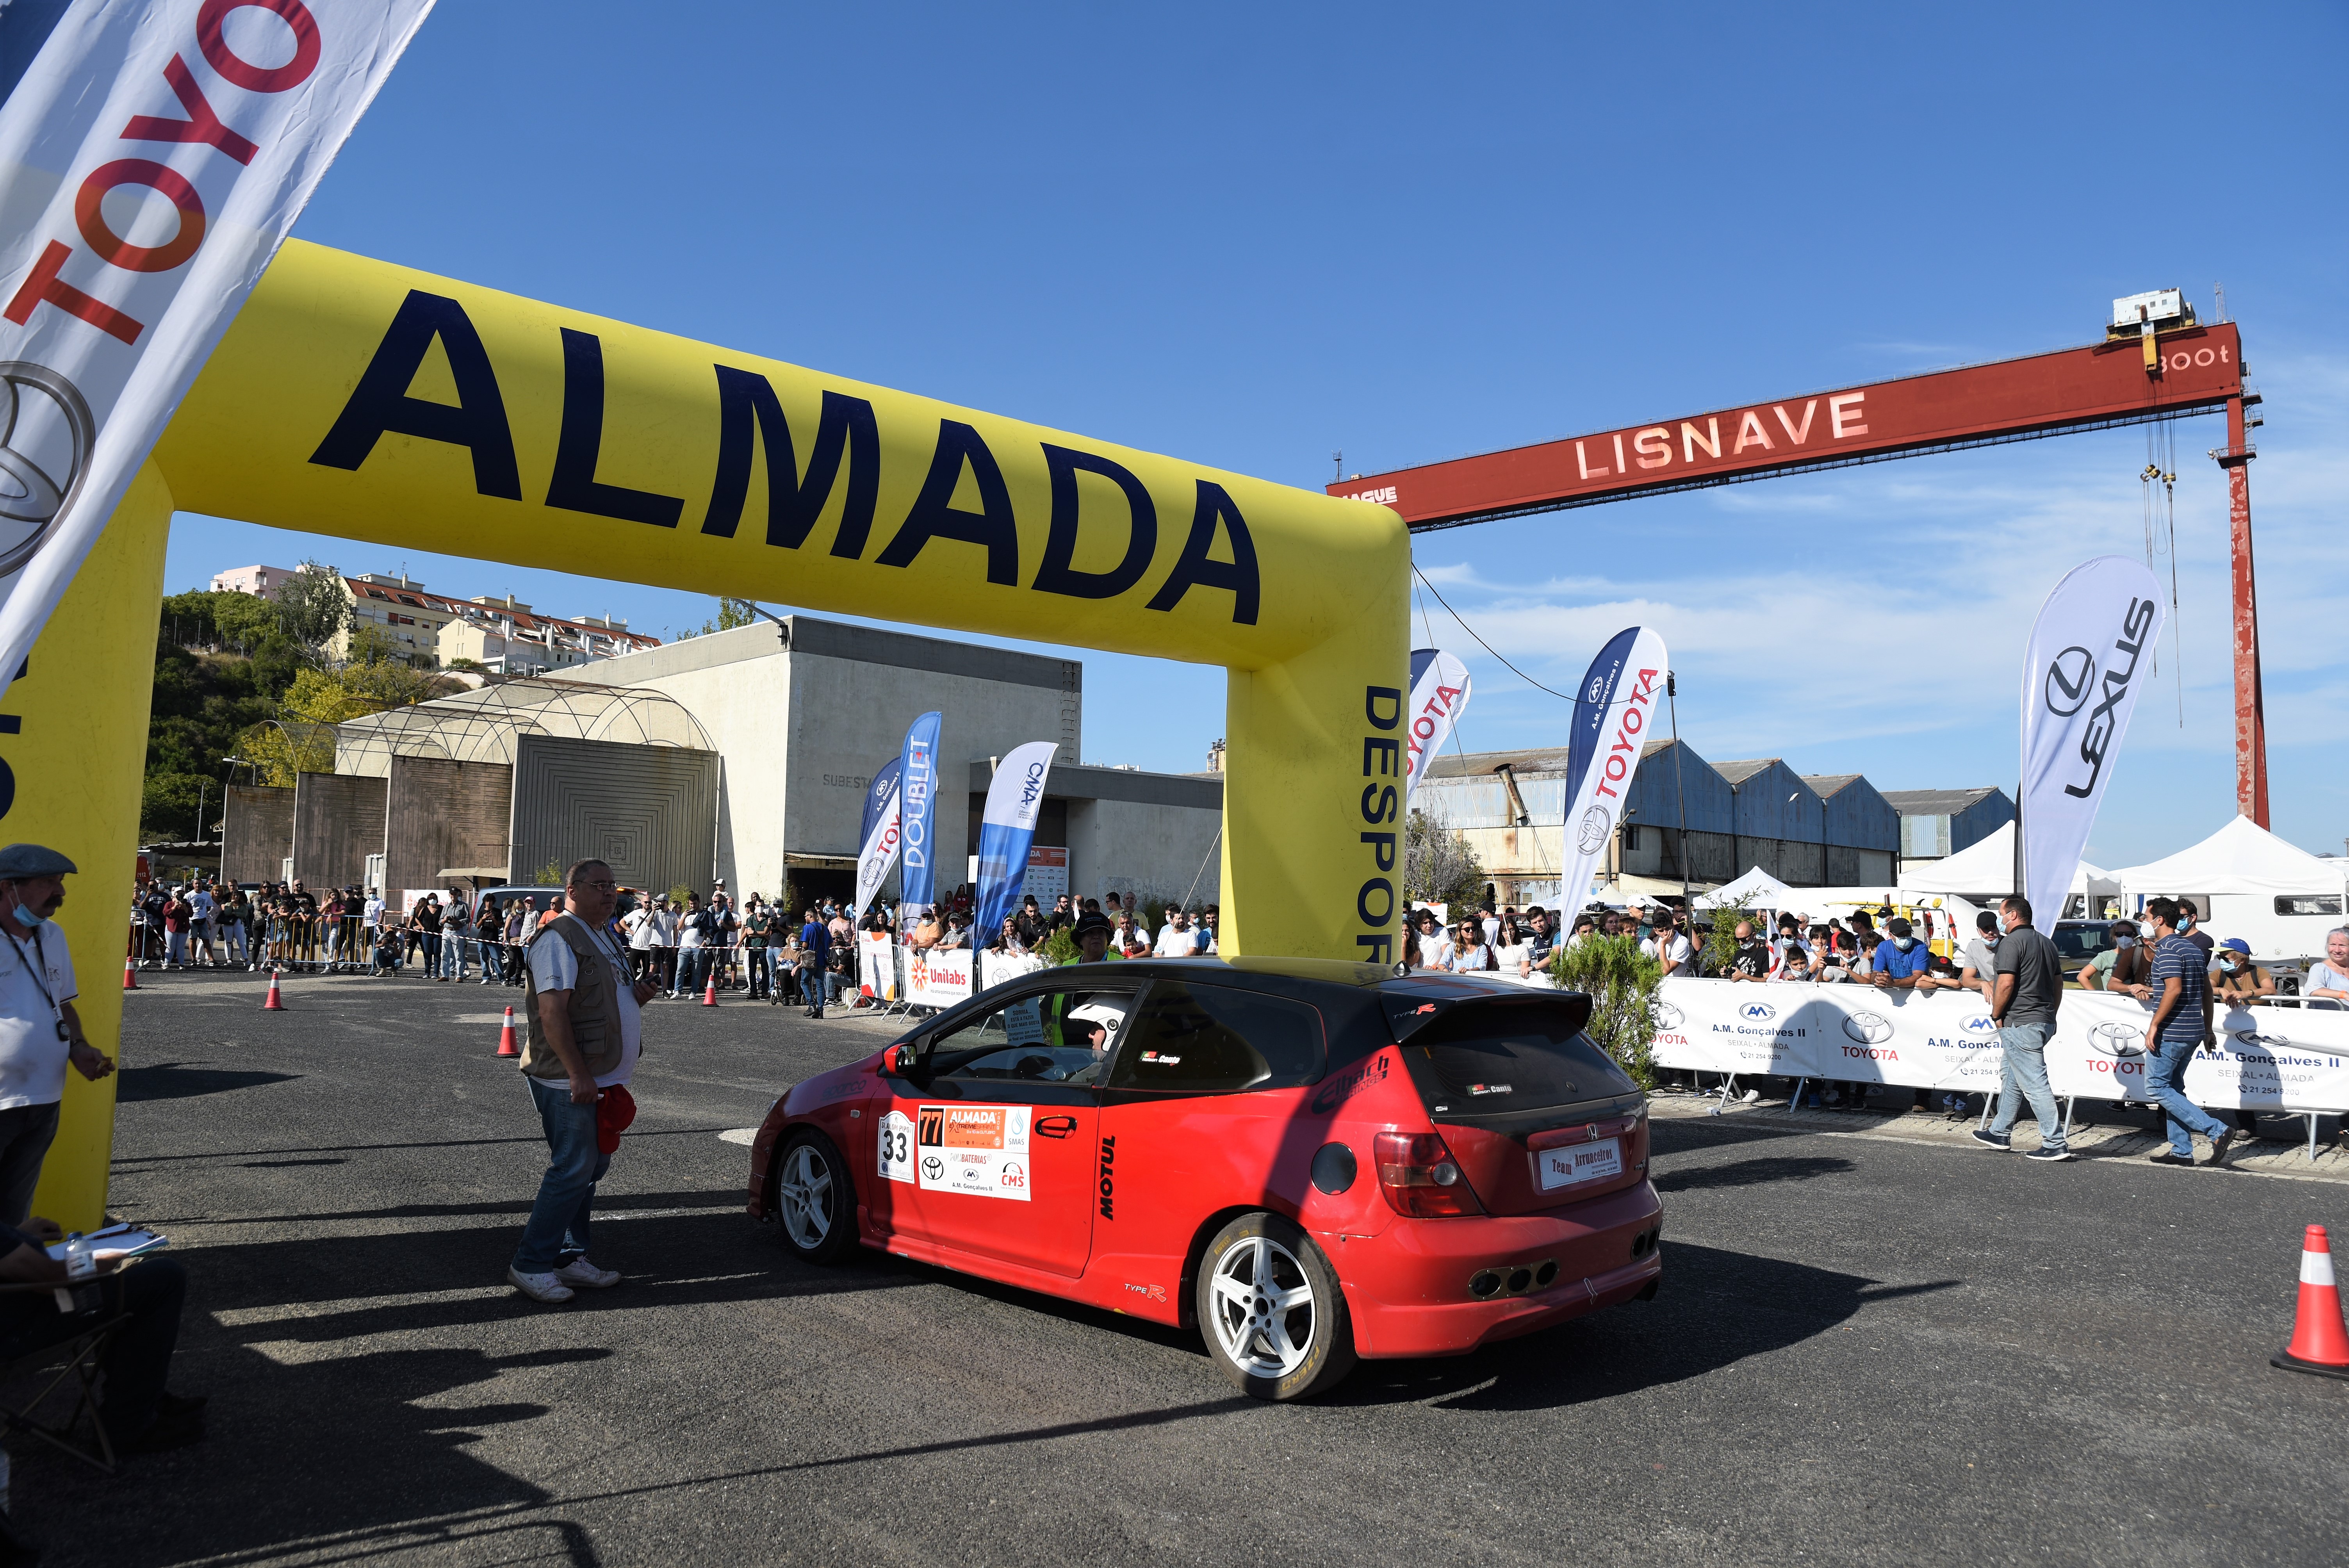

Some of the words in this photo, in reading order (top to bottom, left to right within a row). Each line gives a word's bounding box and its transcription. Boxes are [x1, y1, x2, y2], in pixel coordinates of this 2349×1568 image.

[1576, 392, 1870, 479] LISNAVE
[308, 289, 1259, 626] ALMADA
[1343, 486, 1397, 503] AGUE
[1592, 712, 1601, 729] A.M.
[1598, 670, 1616, 711] Gonçalves
[2064, 597, 2155, 798] LEXUS
[1407, 686, 1461, 776] YOTA
[1595, 669, 1658, 798] TOYOTA
[1021, 763, 1043, 805] CMA
[905, 735, 930, 868] DOUBLET
[930, 968, 966, 985] Unilabs
[1393, 1009, 1416, 1019] TYPE
[1416, 1004, 1436, 1015] R
[1713, 1024, 1734, 1033] A.M.
[1738, 1026, 1794, 1037] Gonçalves
[1798, 1028, 1805, 1037] II
[1727, 1039, 1753, 1048] SEIXAL
[1758, 1042, 1789, 1050] ALMADA
[1928, 1038, 1953, 1048] A.M.
[1158, 1055, 1180, 1064] Canto
[1841, 1046, 1899, 1061] TOYOTA
[2195, 1050, 2229, 1061] A.M.
[2235, 1052, 2322, 1066] Gonçalves
[2329, 1057, 2339, 1067] II
[1312, 1055, 1389, 1114] Eibach
[2218, 1069, 2257, 1079] SEIXAL
[2266, 1073, 2315, 1082] ALMADA
[950, 1111, 996, 1123] ALMADA
[881, 1122, 898, 1131] SLALOM
[920, 1111, 943, 1144] 77
[883, 1130, 907, 1162] 33
[950, 1153, 987, 1164] POLIBATERIAS
[1552, 1158, 1572, 1175] Team
[1575, 1148, 1613, 1167] Arruaceiros
[1002, 1174, 1024, 1187] CMS
[1100, 1135, 1116, 1221] MOTUL
[1125, 1283, 1148, 1294] TYPE
[1147, 1284, 1167, 1303] R
